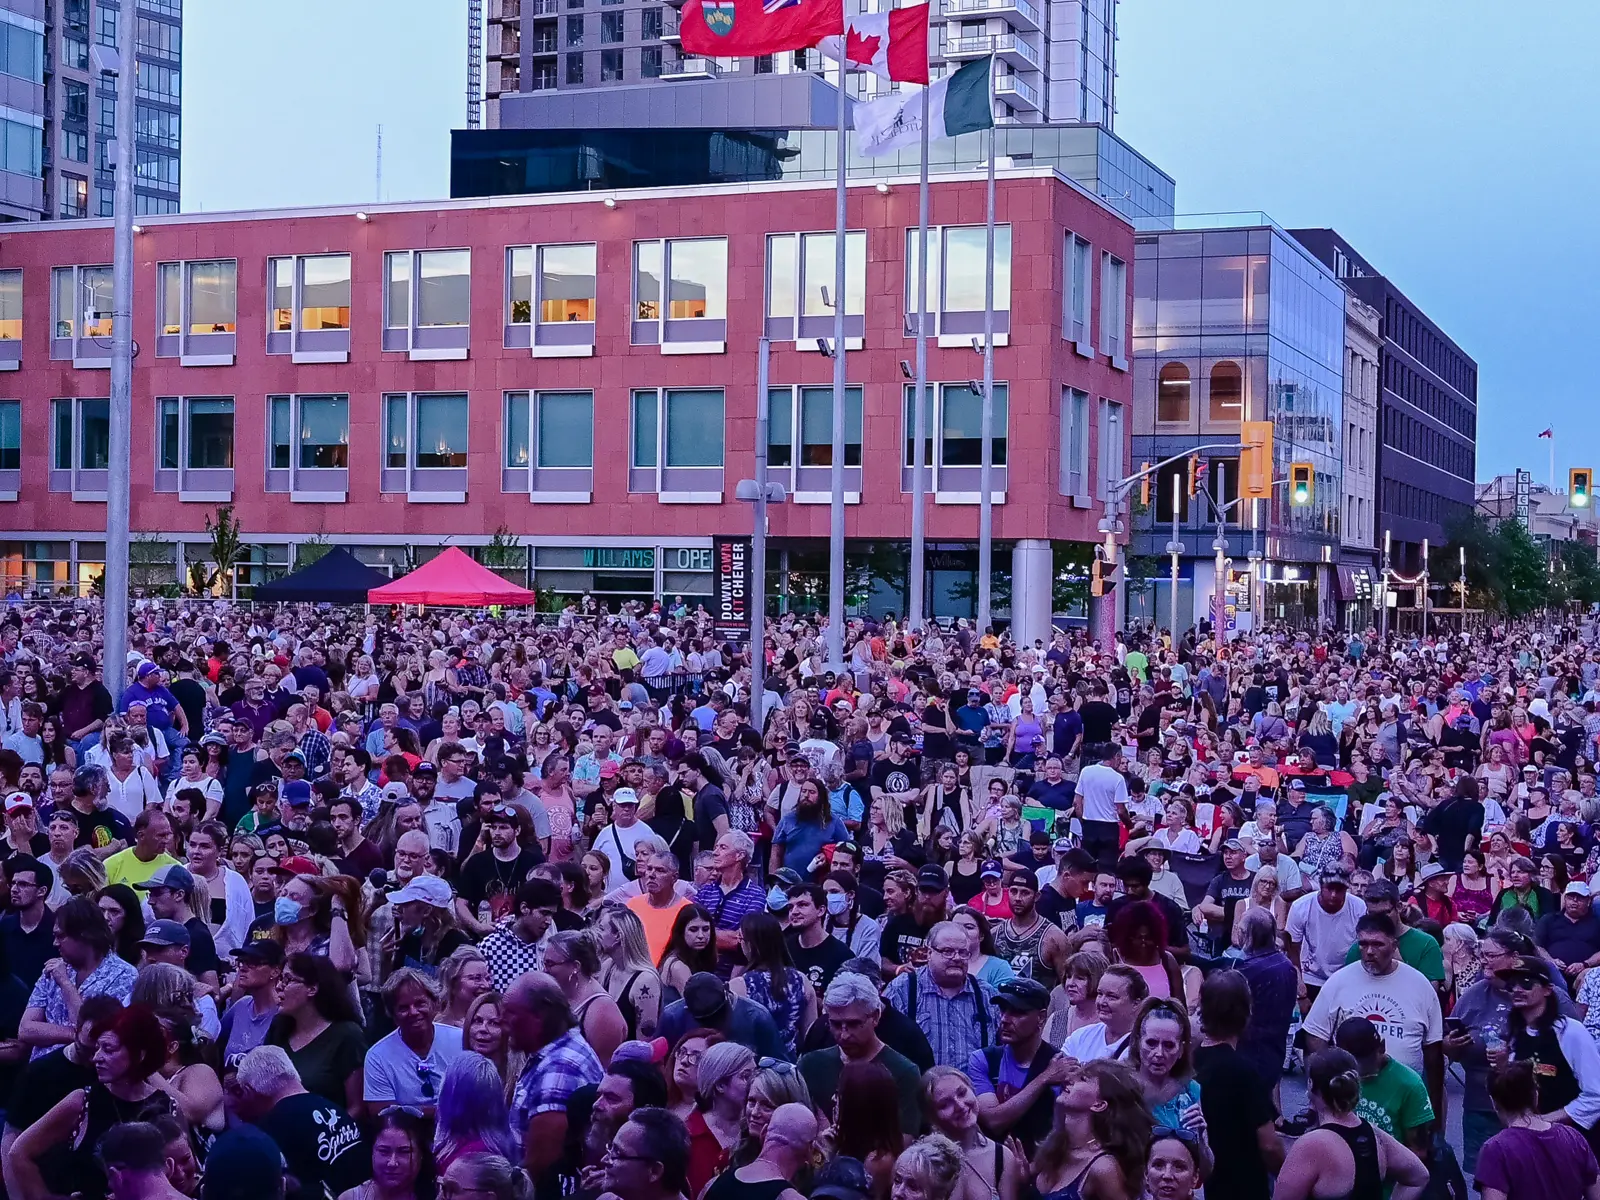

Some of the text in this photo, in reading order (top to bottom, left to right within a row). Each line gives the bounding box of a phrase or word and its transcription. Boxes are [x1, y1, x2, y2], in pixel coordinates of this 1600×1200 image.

[677, 548, 713, 569] OPE
[721, 543, 732, 620] DOWNTOWN
[732, 543, 744, 620] KITCHENER
